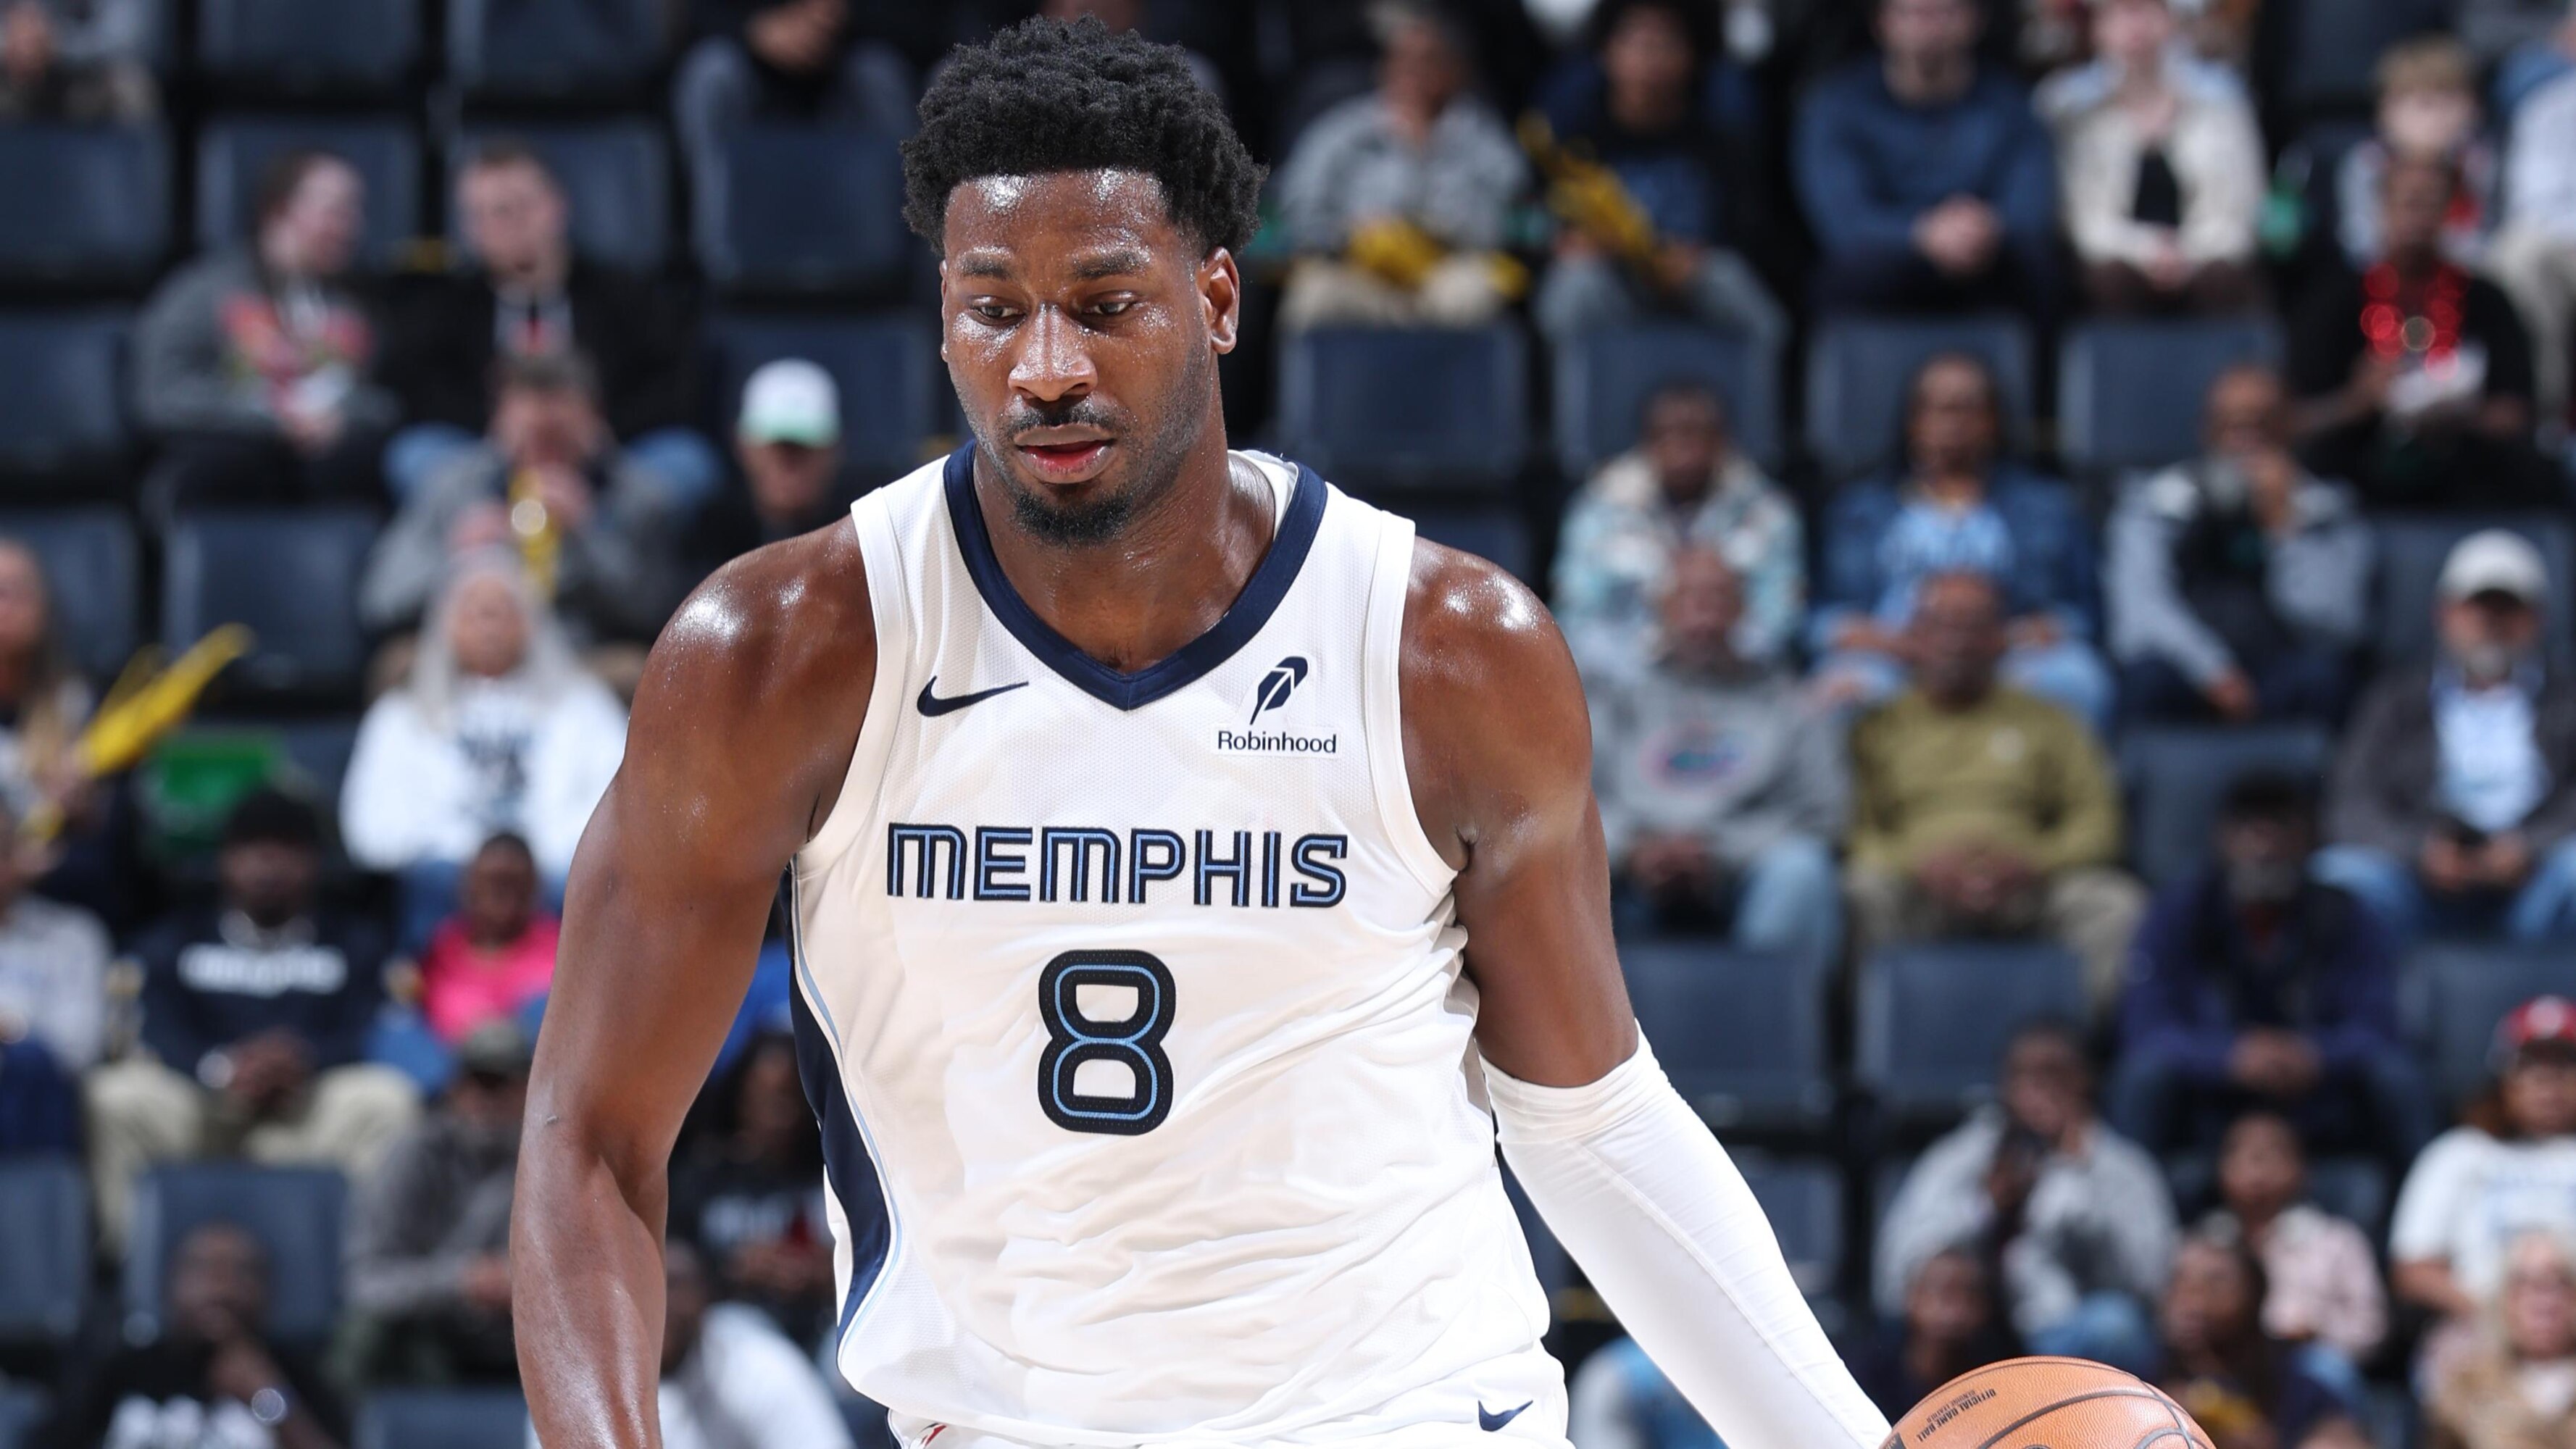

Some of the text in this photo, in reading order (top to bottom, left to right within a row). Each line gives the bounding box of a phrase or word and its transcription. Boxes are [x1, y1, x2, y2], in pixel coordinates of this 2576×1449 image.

[1217, 730, 1337, 754] Robinhood
[887, 822, 1349, 908] MEMPHIS
[1038, 949, 1176, 1136] 8
[1917, 1388, 1996, 1442] OFFICIAL GAME BALL
